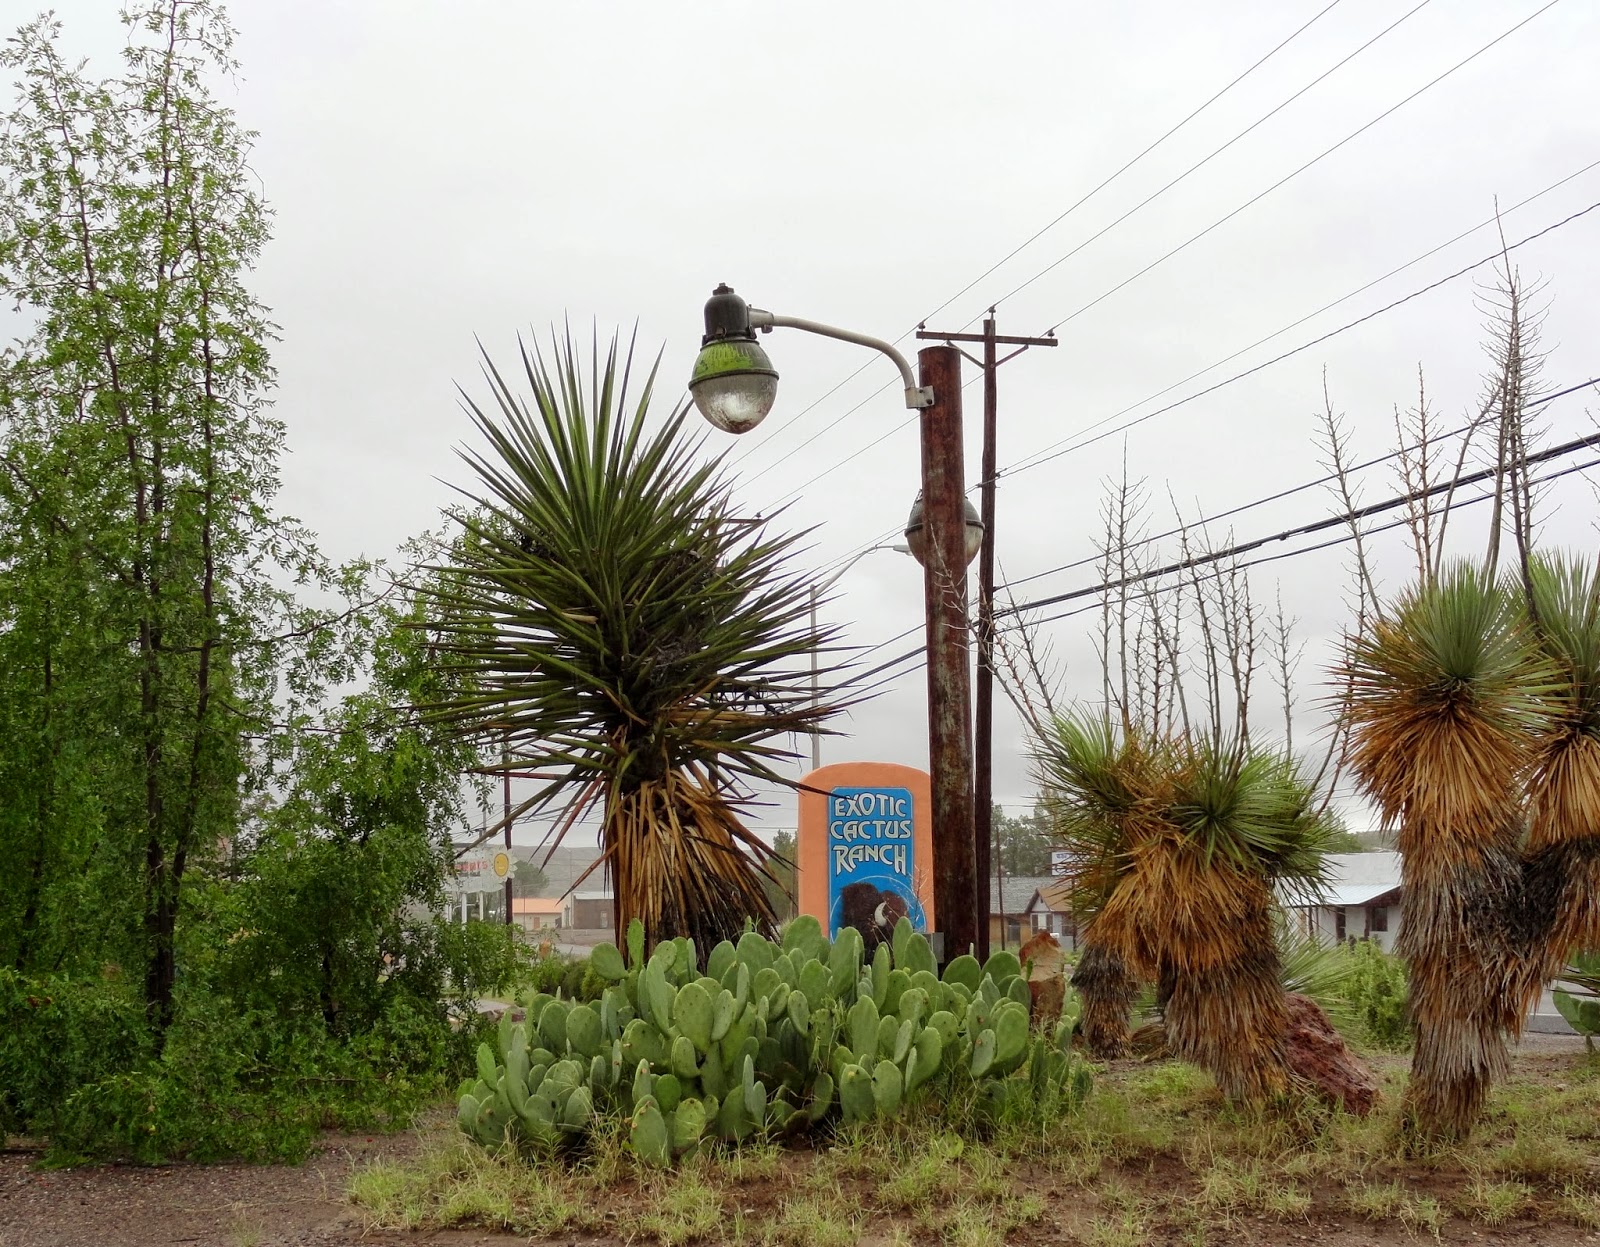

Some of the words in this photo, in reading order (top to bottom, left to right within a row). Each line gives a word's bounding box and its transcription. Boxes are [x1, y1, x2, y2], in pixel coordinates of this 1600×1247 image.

[834, 792, 907, 818] EXOTIC
[830, 820, 912, 843] CACTUS
[832, 844, 907, 876] RANCH
